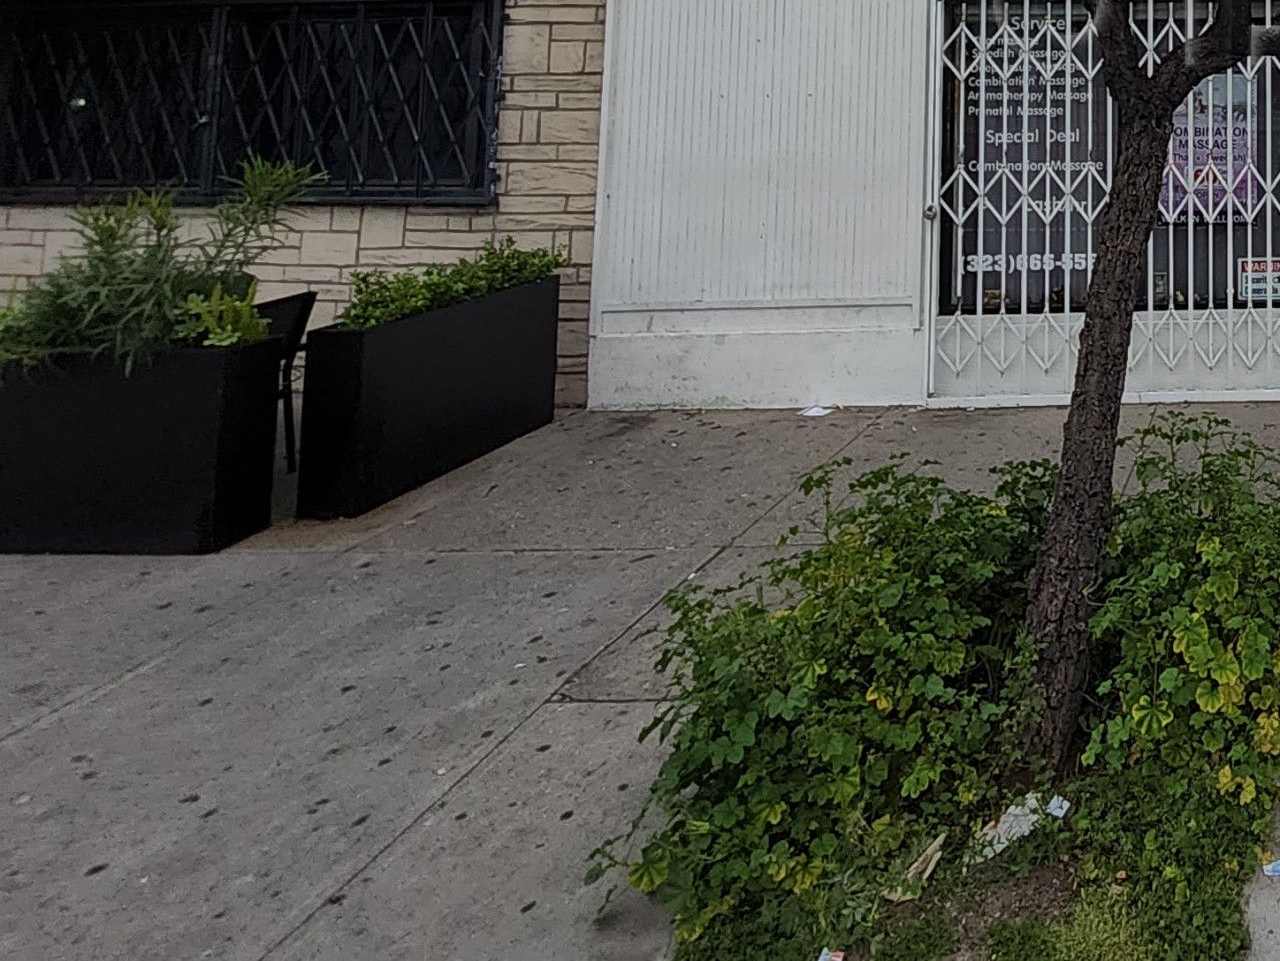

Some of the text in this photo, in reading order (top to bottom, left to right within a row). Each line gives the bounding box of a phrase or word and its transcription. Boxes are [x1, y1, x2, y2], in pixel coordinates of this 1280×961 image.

[1011, 16, 1066, 31] Servce
[971, 48, 1066, 60] Sedih assge
[968, 77, 1086, 88] Combiatin Massge
[967, 91, 1044, 103] Armaherpy
[968, 105, 1013, 116] Prnatal
[985, 128, 1039, 146] Specal
[1179, 139, 1237, 150] MSSAGE
[968, 160, 1045, 172] Combnaion
